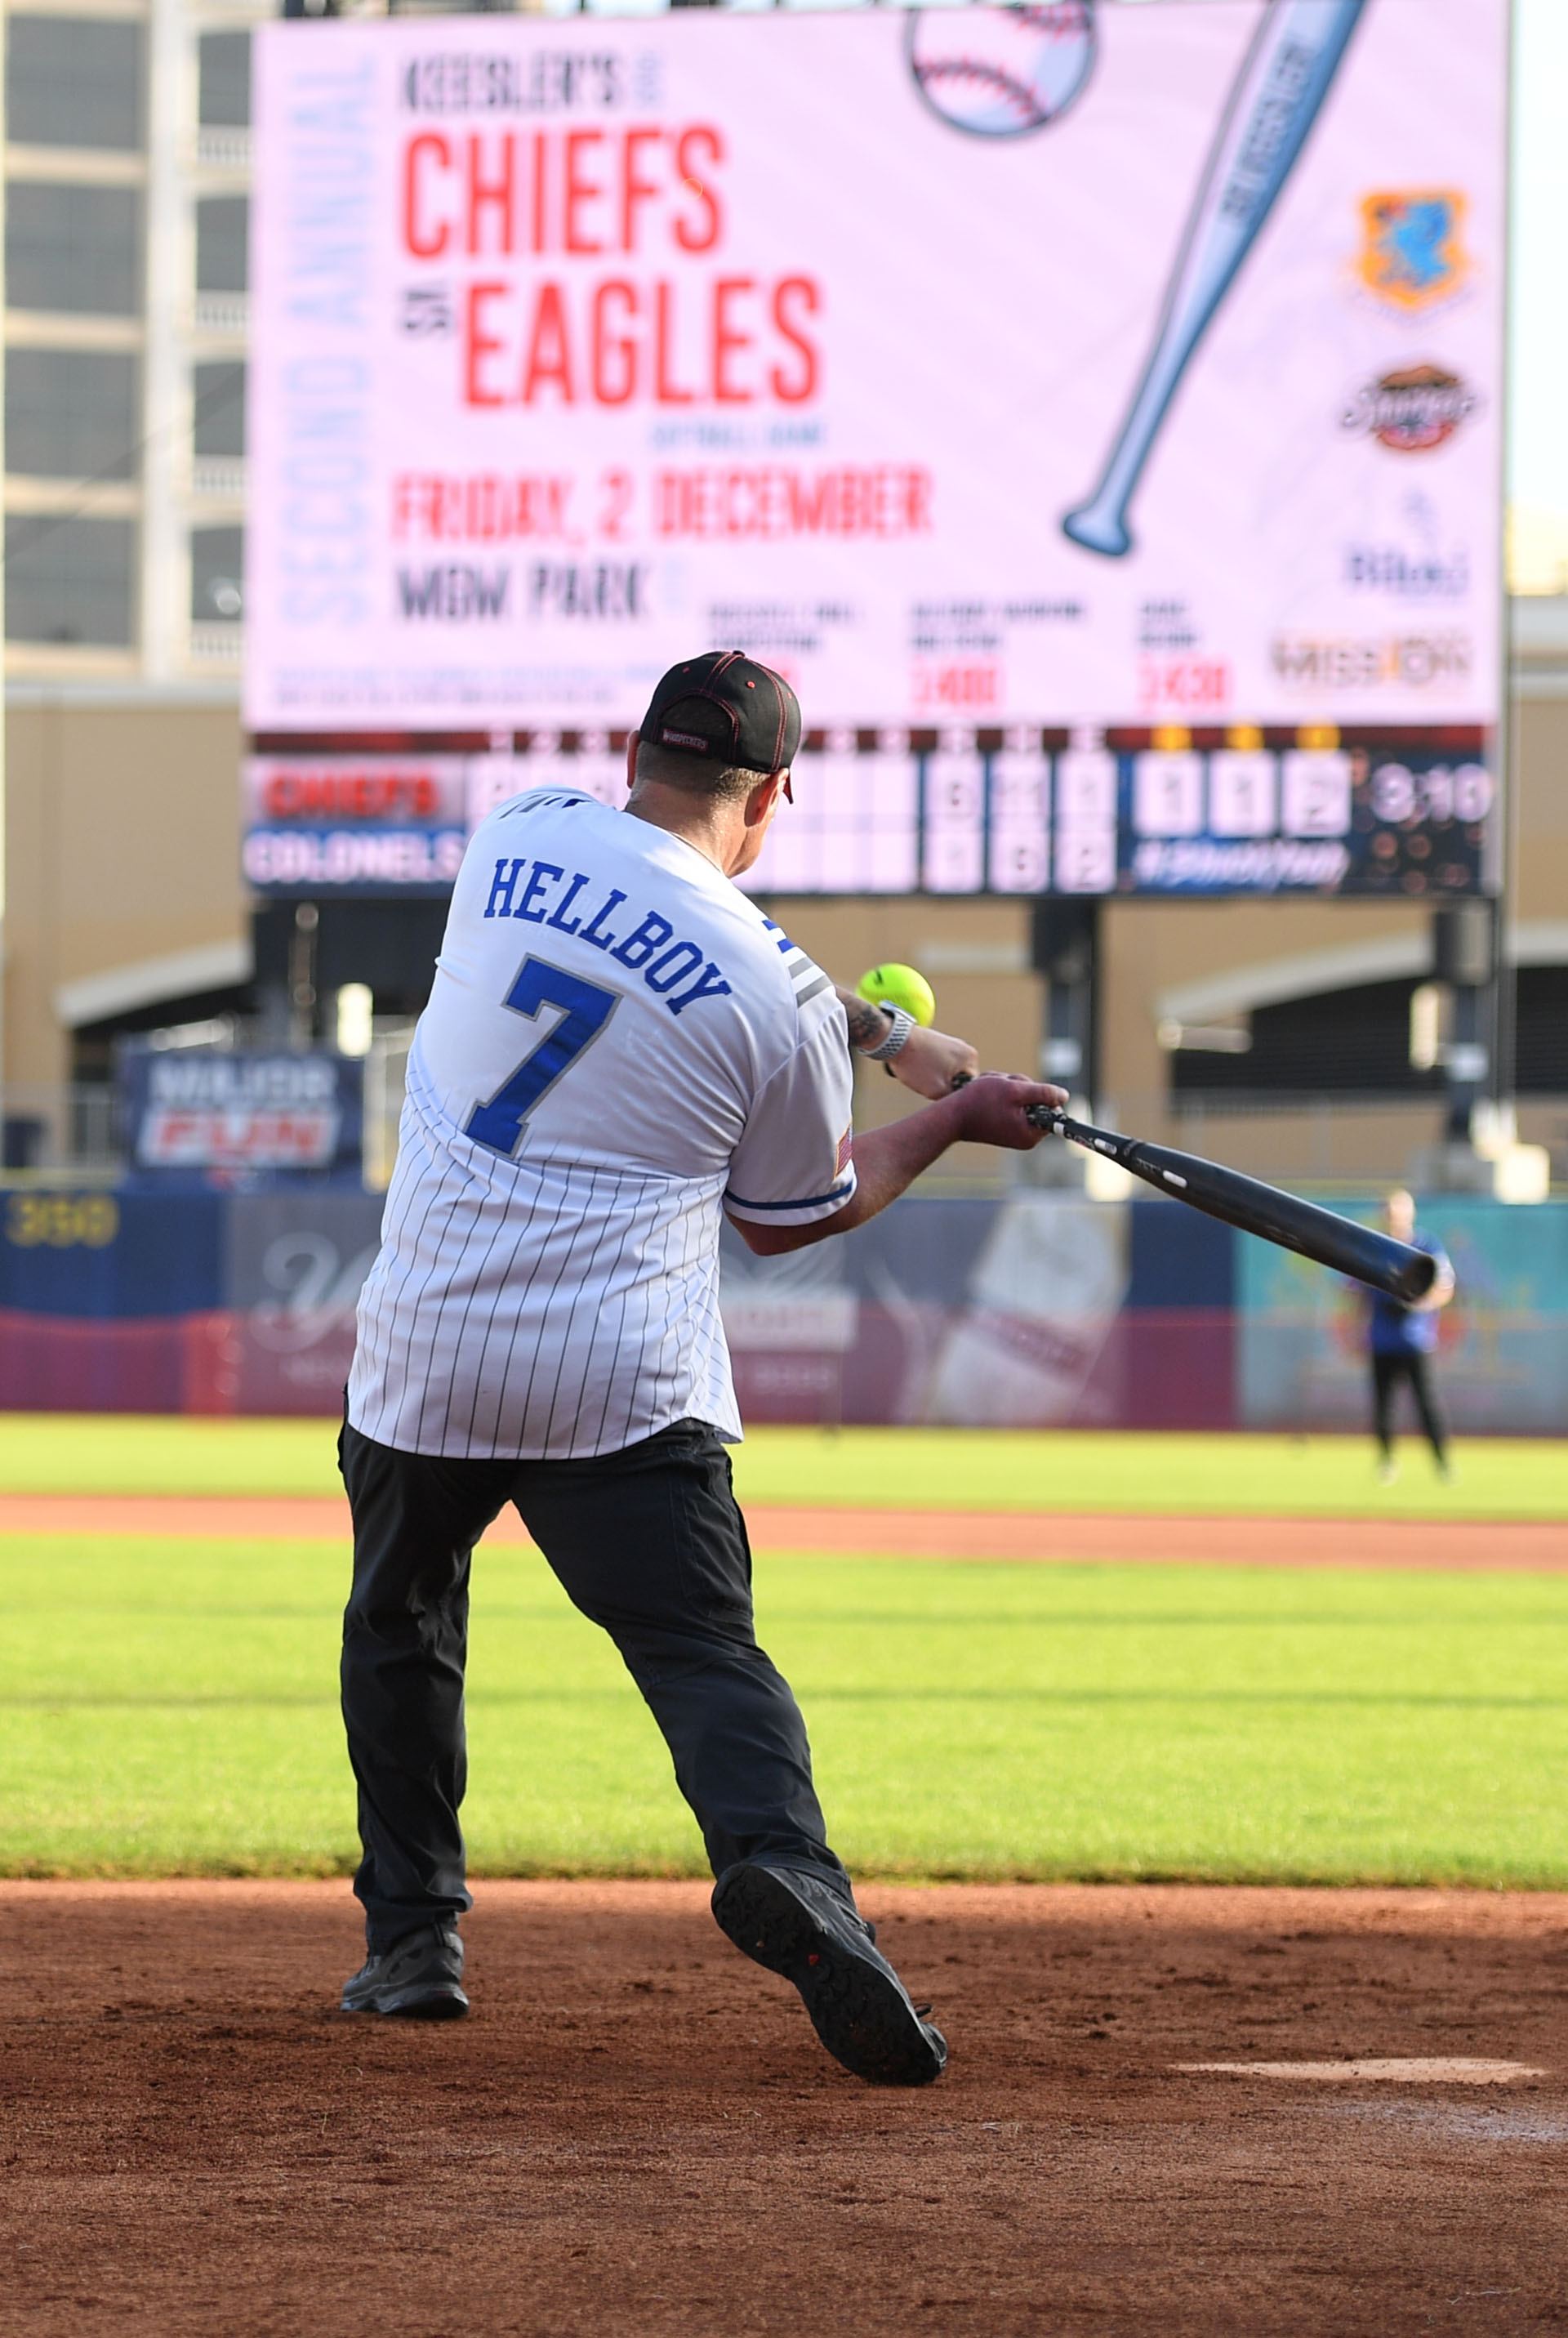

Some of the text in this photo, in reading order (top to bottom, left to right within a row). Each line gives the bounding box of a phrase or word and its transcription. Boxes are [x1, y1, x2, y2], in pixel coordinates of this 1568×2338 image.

[401, 124, 726, 259] CHIEFS
[462, 276, 825, 408] EAGLES
[393, 464, 933, 551] FRIDAY, 2 DECEMBER
[531, 560, 651, 621] PARK
[265, 771, 440, 815] CHIEFS
[483, 859, 733, 1015] HELLBOY
[464, 953, 623, 1160] 7
